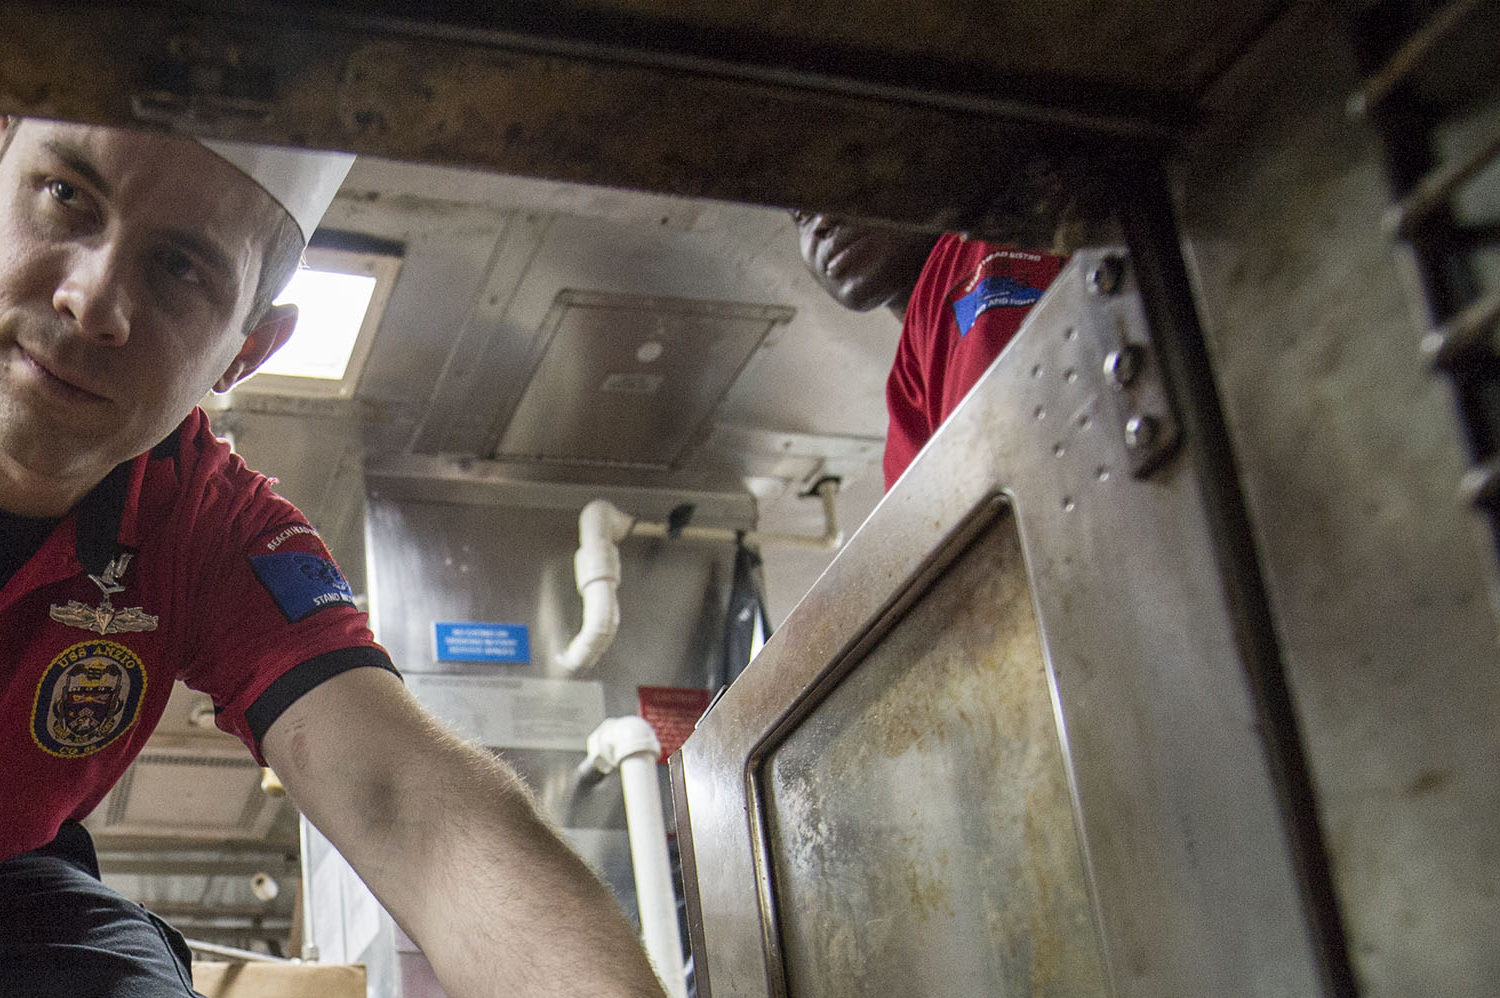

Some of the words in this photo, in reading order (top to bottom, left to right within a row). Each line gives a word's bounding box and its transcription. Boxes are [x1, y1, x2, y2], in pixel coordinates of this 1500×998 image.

[313, 592, 341, 607] STAND
[57, 647, 88, 669] USS
[92, 645, 136, 670] ANZIO
